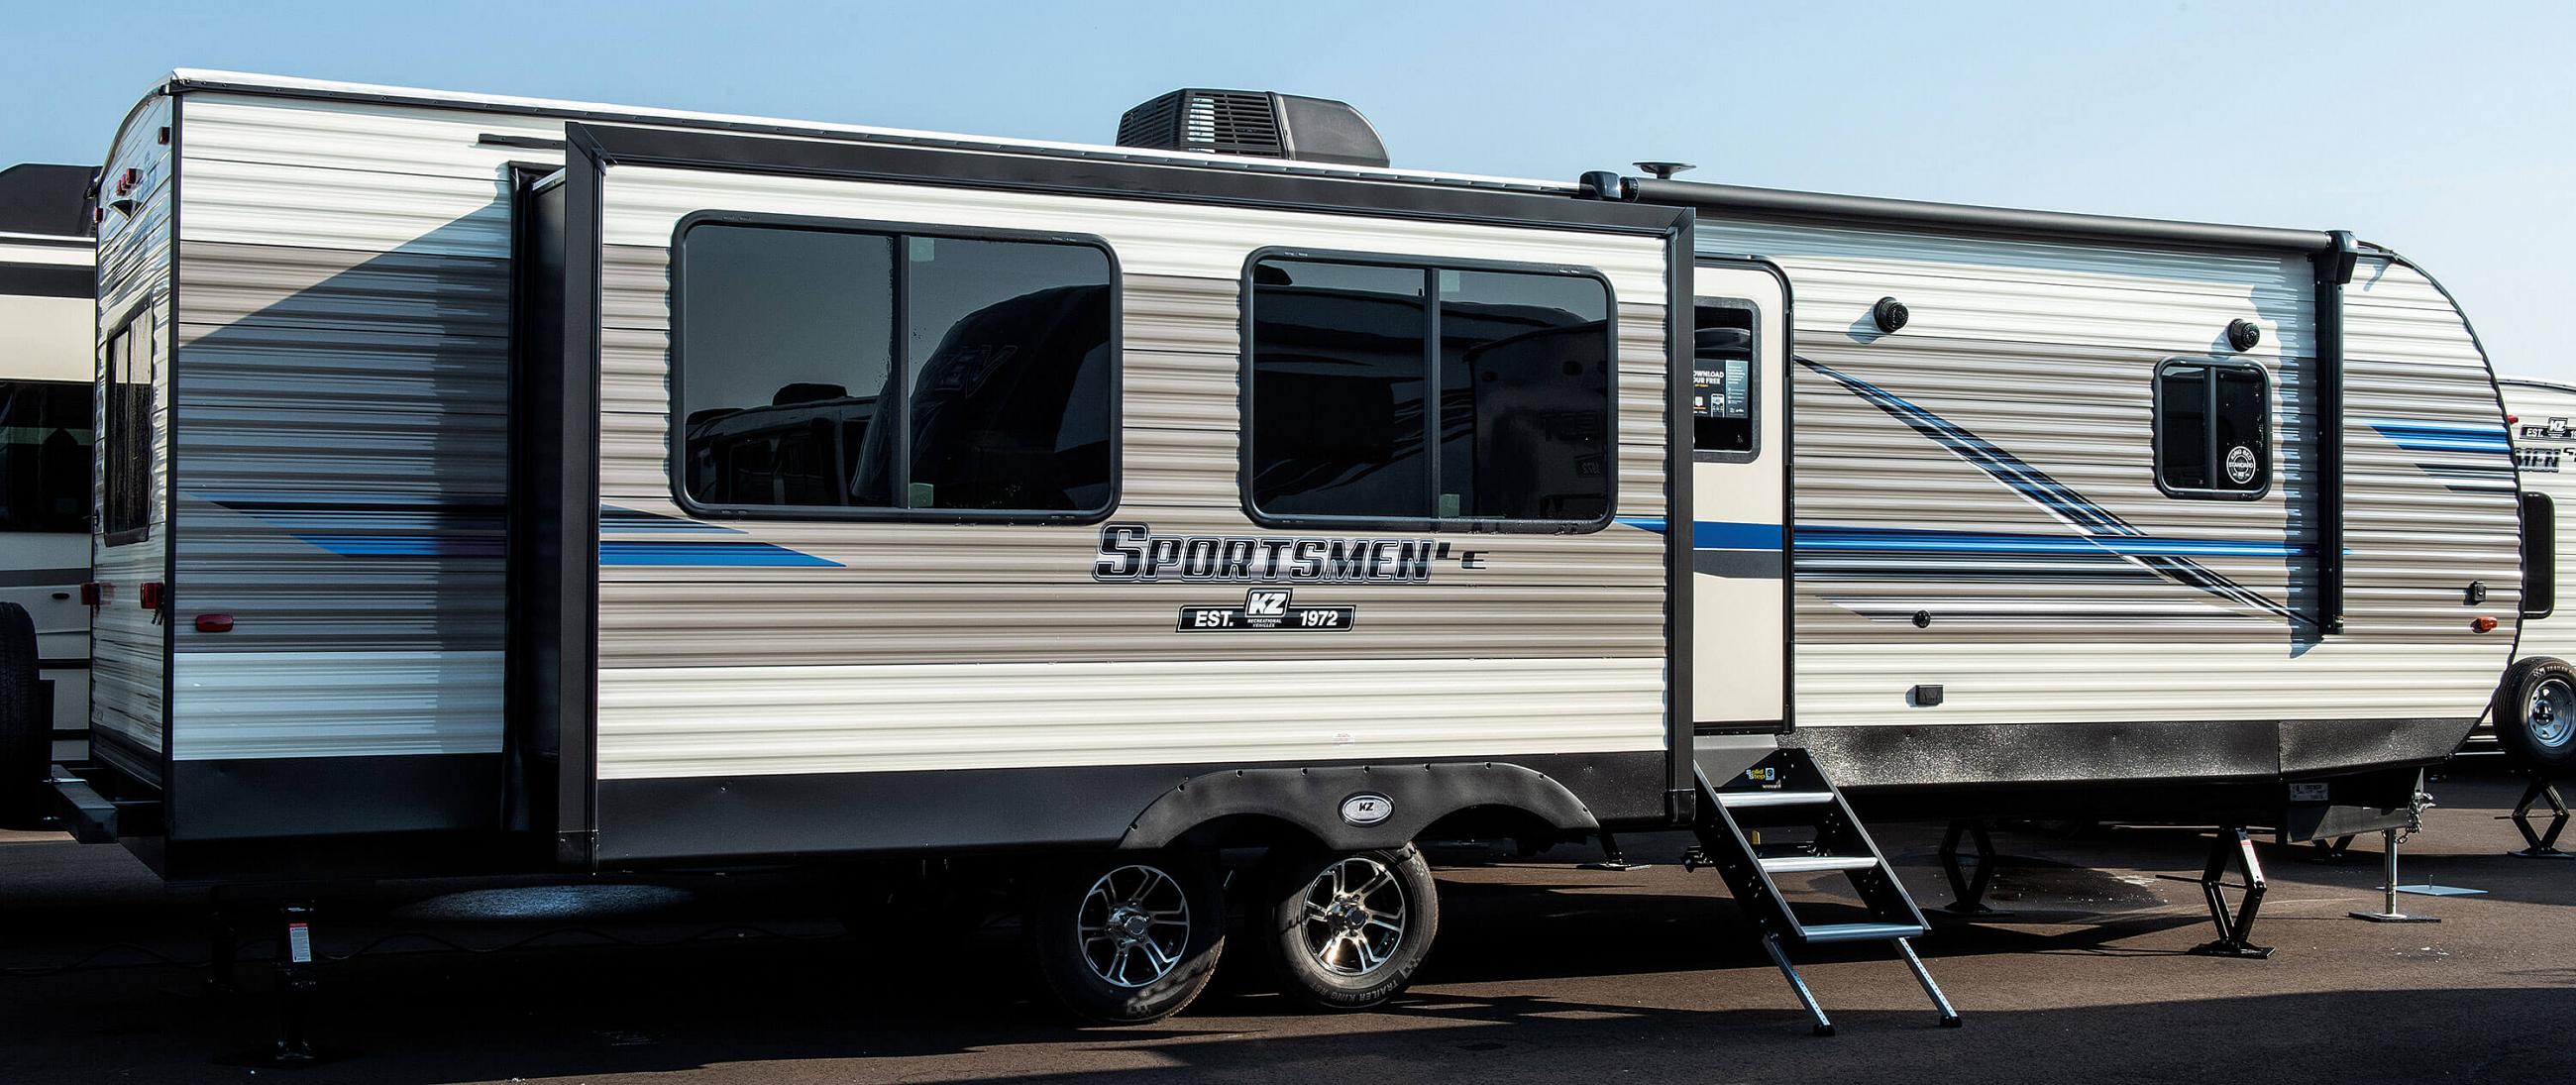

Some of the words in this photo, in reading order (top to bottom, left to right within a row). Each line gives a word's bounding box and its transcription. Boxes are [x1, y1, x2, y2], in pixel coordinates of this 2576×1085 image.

[2526, 428, 2543, 437] EST.
[1248, 593, 1287, 615] KZ
[1194, 610, 1234, 627] EST.
[1300, 610, 1338, 626] 1972
[1358, 802, 1375, 812] KZ
[1331, 991, 1355, 1002] KING
[1358, 979, 1399, 1001] TRAILER
